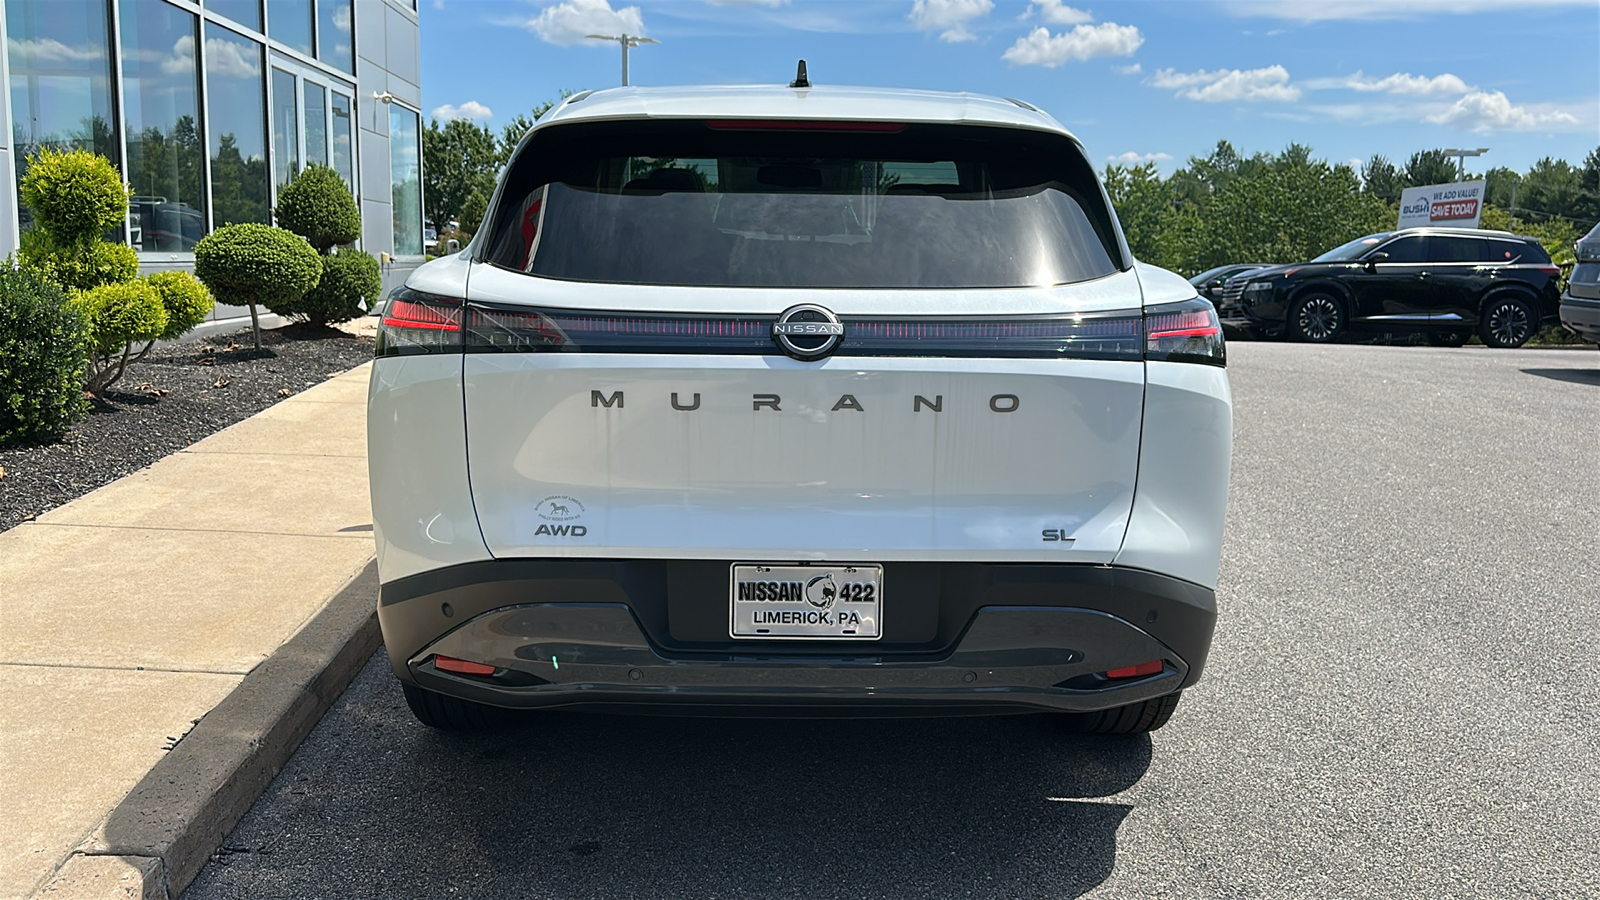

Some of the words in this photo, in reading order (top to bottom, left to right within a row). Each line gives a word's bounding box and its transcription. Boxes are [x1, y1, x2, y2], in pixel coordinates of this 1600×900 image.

[1433, 191, 1442, 200] WE
[1443, 190, 1456, 199] ADD
[1457, 188, 1479, 198] VALUE!
[1431, 204, 1449, 217] SAVE
[1451, 202, 1476, 216] TODAY
[774, 325, 841, 334] NISSAN
[591, 390, 1020, 412] MURANO
[534, 524, 587, 536] AWD
[1042, 529, 1076, 541] SL
[738, 581, 803, 602] NISSAN
[839, 583, 875, 603] 422
[754, 612, 834, 626] LIMERICK,
[838, 612, 860, 625] PA
